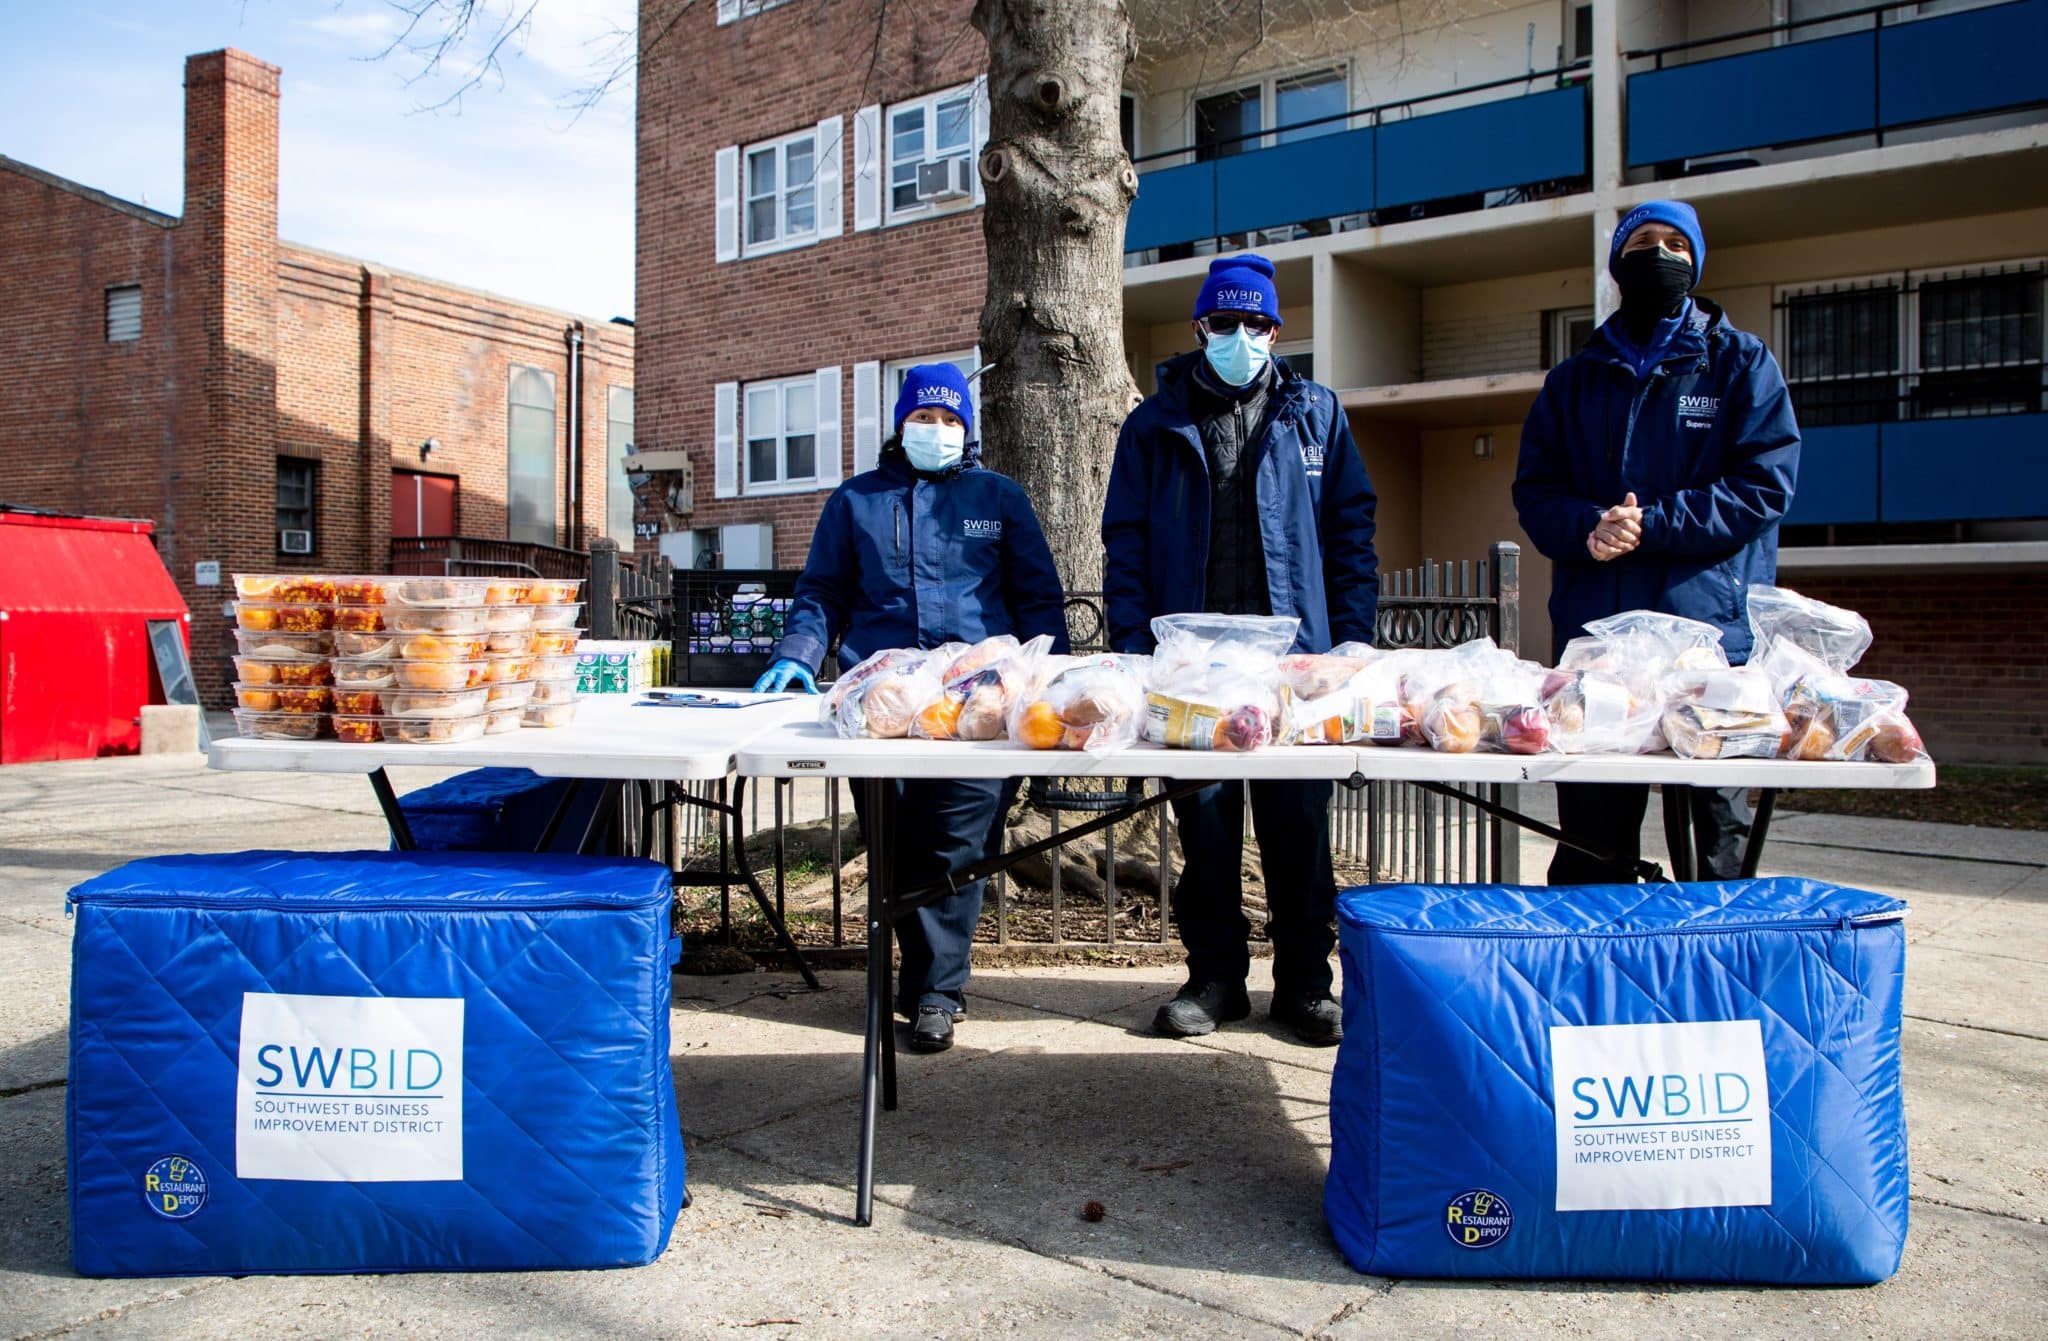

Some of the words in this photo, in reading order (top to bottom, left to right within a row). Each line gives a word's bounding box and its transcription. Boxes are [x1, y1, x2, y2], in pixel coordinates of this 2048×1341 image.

[1216, 289, 1263, 302] SWBID
[917, 385, 962, 403] SWBID
[963, 519, 1002, 531] SWBID
[255, 1044, 443, 1090] SWBID
[1571, 1072, 1751, 1120] SWBID
[255, 1100, 350, 1115] SOUTHWEST
[354, 1103, 429, 1116] BUSINESS
[254, 1119, 369, 1133] IMPROVEMENT
[373, 1121, 444, 1133] DISTRICT
[1574, 1131, 1667, 1146] SOUTHWEST
[1671, 1128, 1741, 1143] BUSINESS
[1575, 1148, 1685, 1163] IMPROVEMENT
[1690, 1144, 1755, 1160] DISTRICT
[145, 1174, 206, 1192] RESTAURANT
[163, 1194, 200, 1211] DEPOT
[1448, 1206, 1511, 1226] RESTAURANT
[1464, 1227, 1502, 1243] DEPOT
